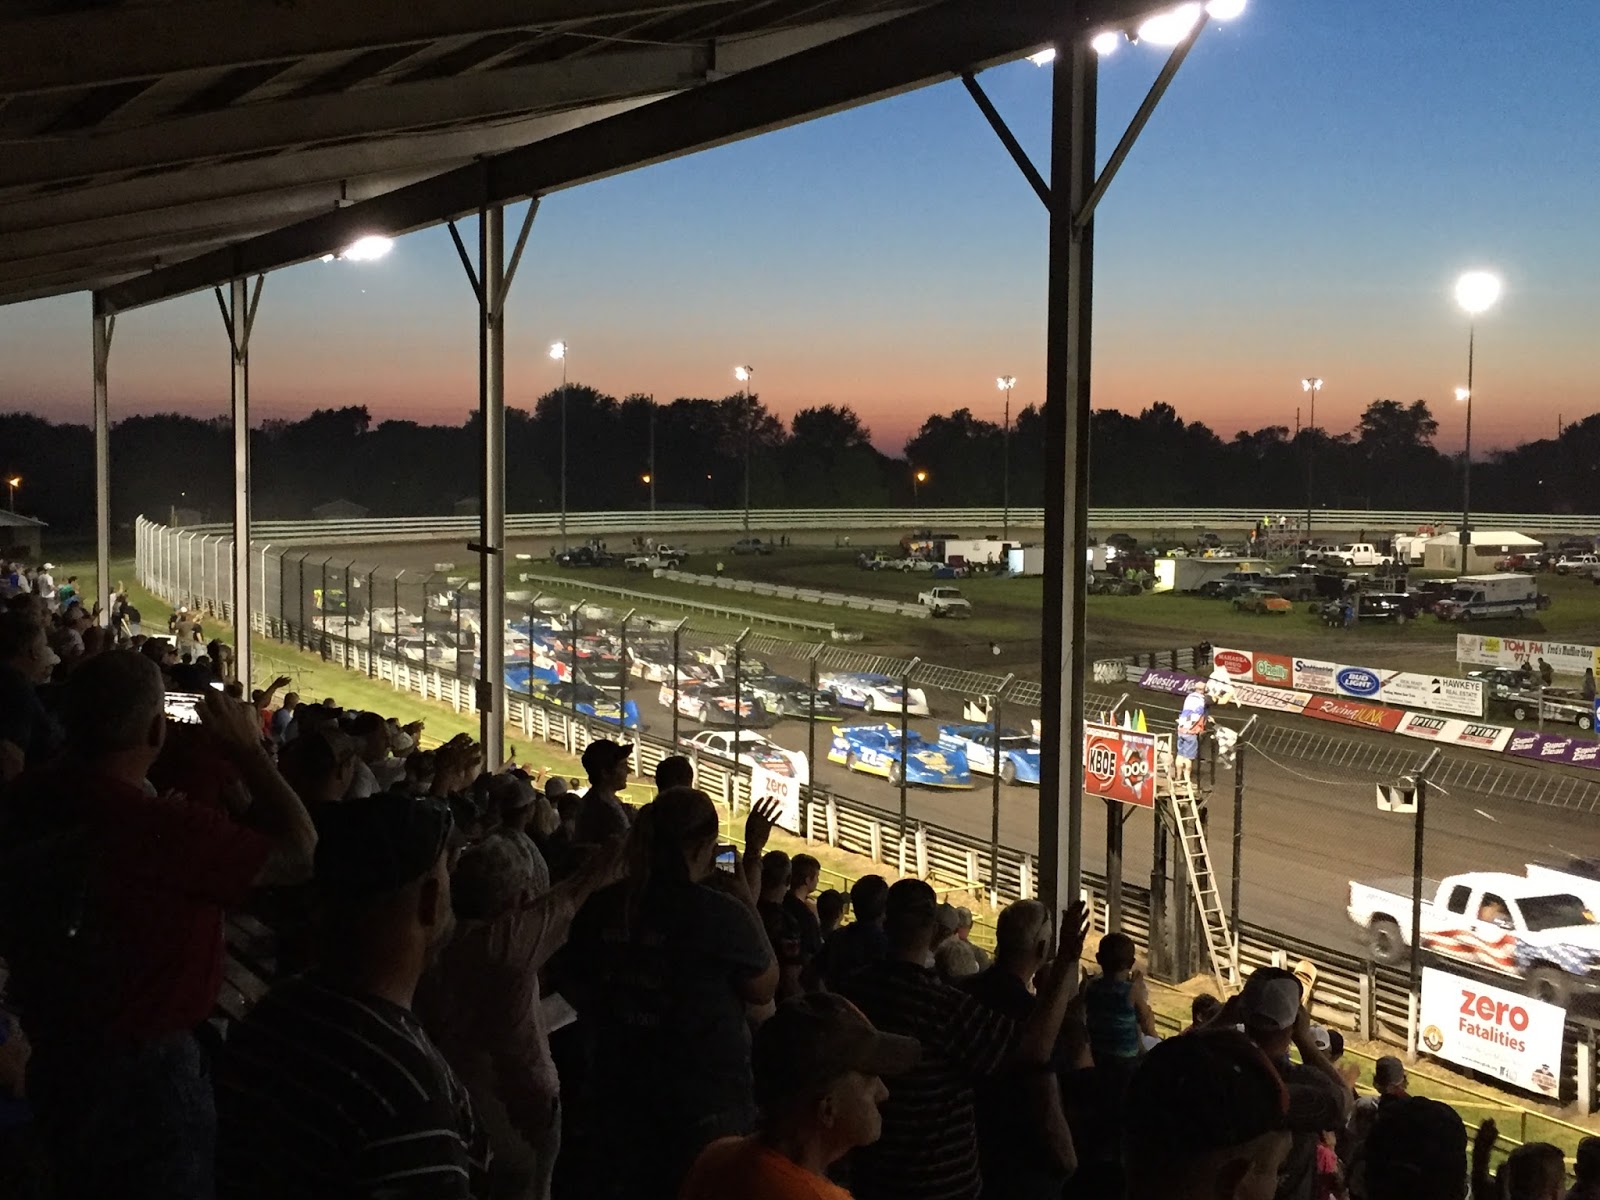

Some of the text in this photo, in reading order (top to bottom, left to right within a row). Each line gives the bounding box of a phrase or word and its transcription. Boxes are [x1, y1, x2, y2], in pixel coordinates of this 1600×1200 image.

[1503, 640, 1526, 653] TOM
[1529, 643, 1544, 655] FM
[1514, 653, 1531, 663] 97.7
[1348, 673, 1369, 681] BUD
[1344, 679, 1372, 688] LIGHT
[1442, 679, 1480, 691] HAWKEYE
[1459, 690, 1478, 698] ESTATE
[1410, 715, 1447, 731] OPTIMA
[1464, 724, 1502, 739] OPTIMA
[1541, 747, 1565, 755] Clean
[1543, 741, 1568, 750] Super
[1574, 746, 1598, 755] Super
[1089, 748, 1116, 776] KBOE
[1572, 752, 1596, 761] Clean
[1124, 761, 1149, 777] DOO
[766, 777, 788, 797] zero
[1460, 989, 1529, 1032] zero
[1459, 1017, 1526, 1053] Fatalities
